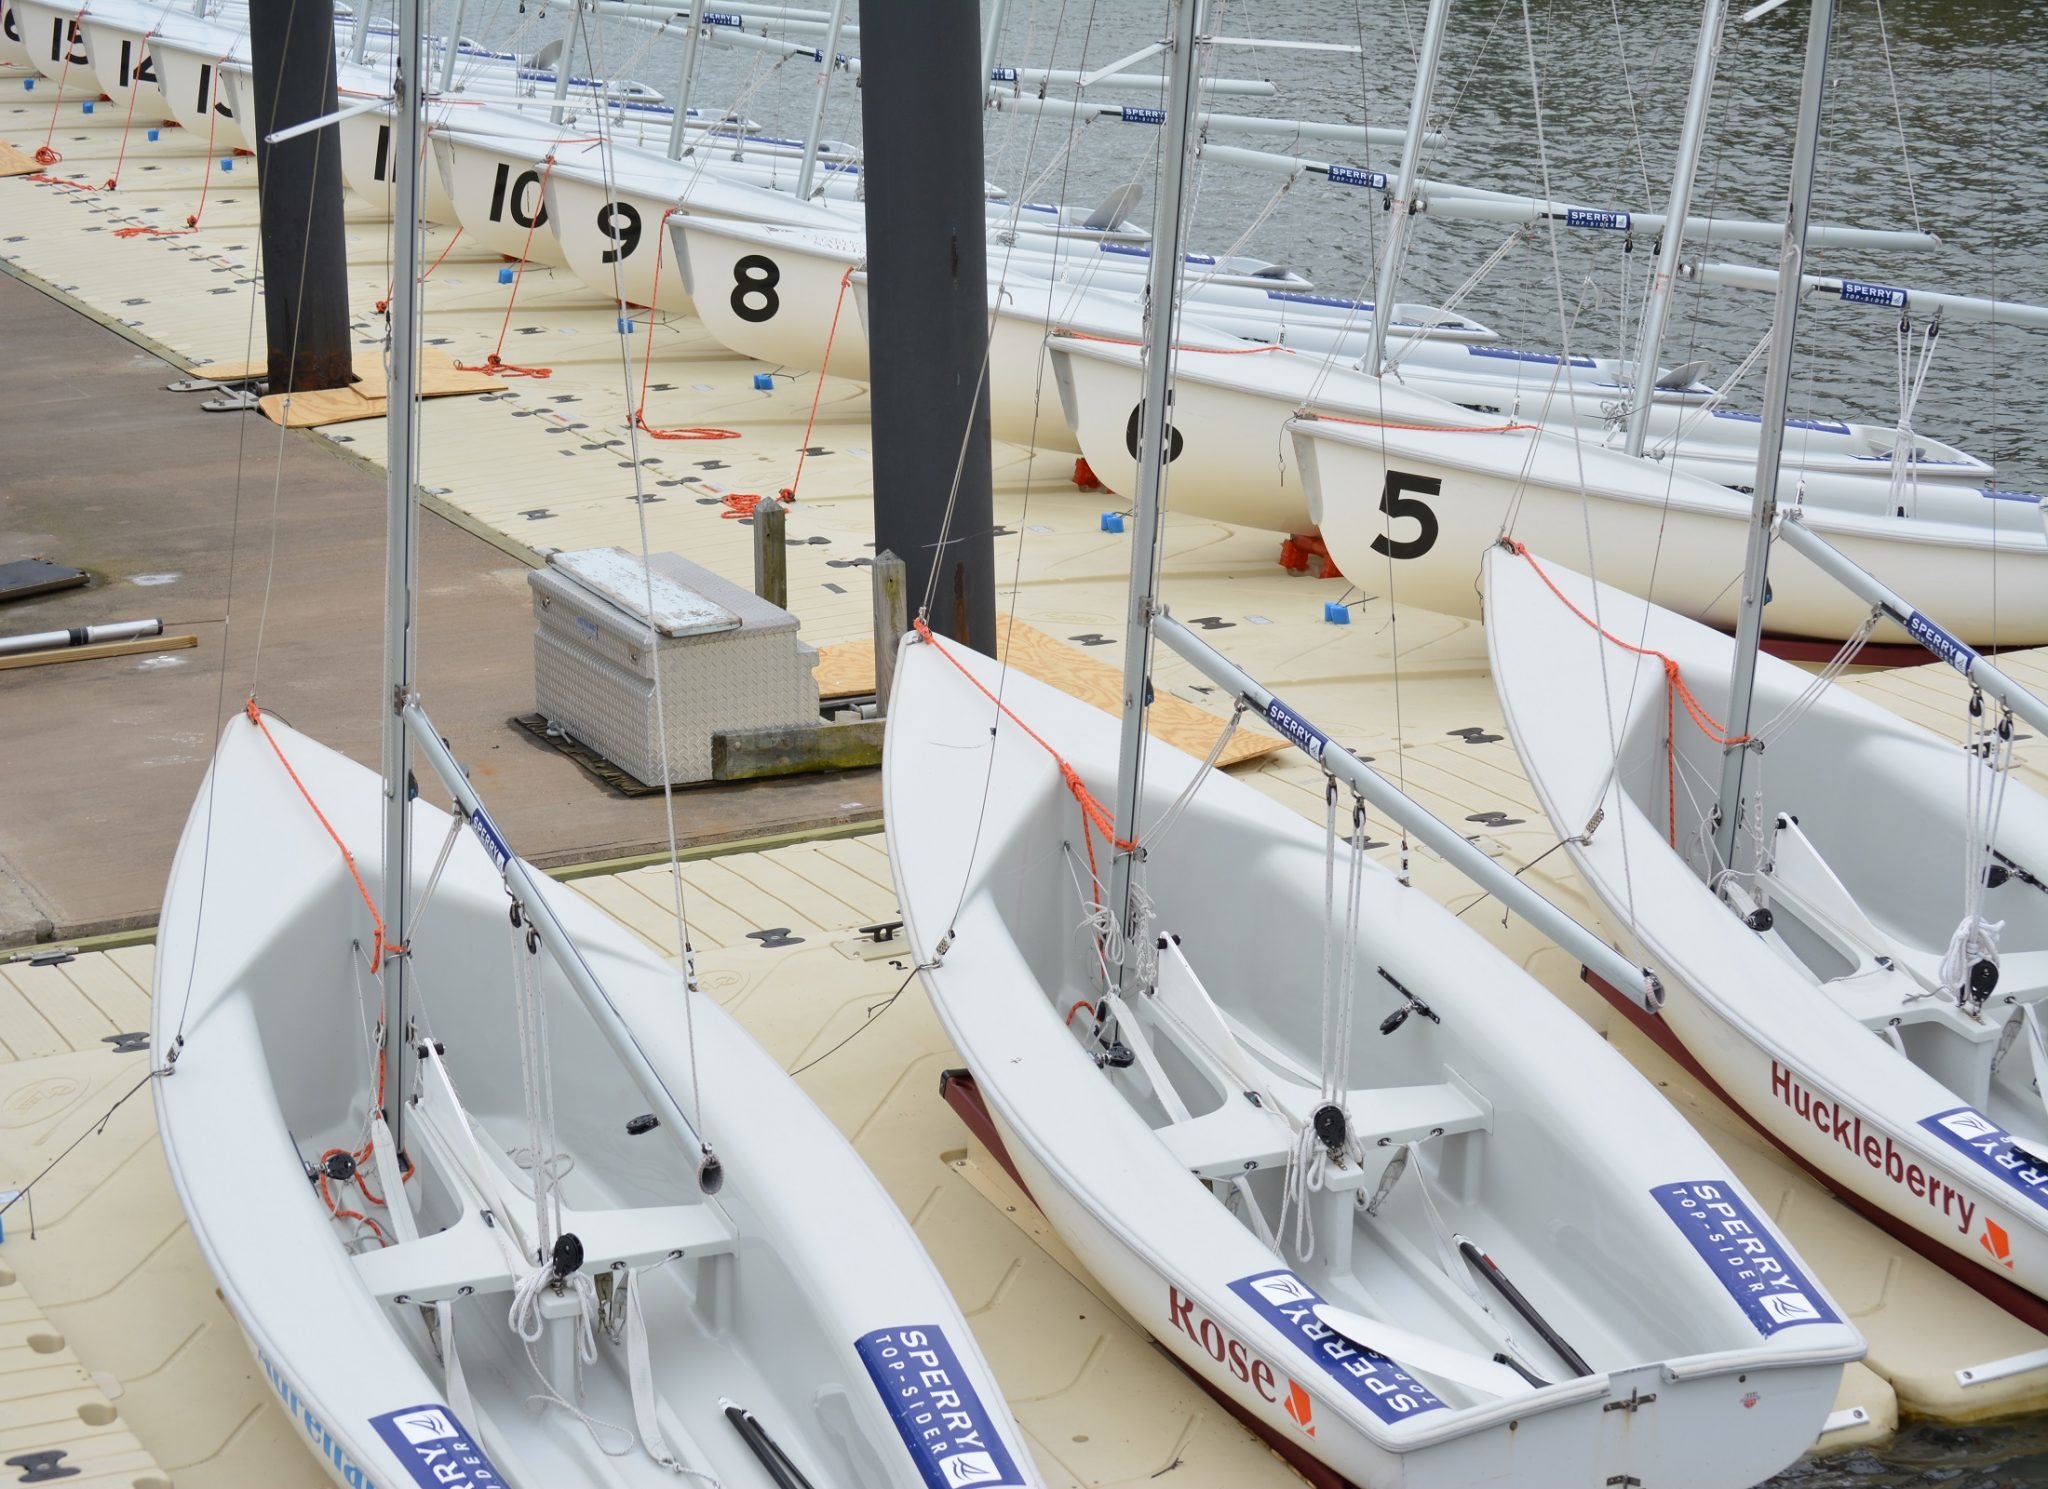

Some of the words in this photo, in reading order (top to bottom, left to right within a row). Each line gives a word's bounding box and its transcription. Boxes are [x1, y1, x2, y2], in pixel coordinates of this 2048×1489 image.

[489, 163, 550, 228] 10
[1332, 167, 1373, 180] SPERRY
[597, 201, 642, 264] 9
[1571, 211, 1616, 222] SPERRY
[730, 254, 780, 323] 8
[1846, 284, 1892, 299] SPERRY
[1126, 389, 1184, 465] 6
[1370, 470, 1442, 560] 5
[1910, 617, 1957, 657] SPERRY
[1269, 705, 1312, 743] SPERRY
[473, 816, 500, 858] SPERRY
[1771, 1060, 1976, 1235] Huckleberry
[1672, 1188, 1765, 1292] TOP-SIDER
[1693, 1185, 1799, 1290] SPERRY
[1168, 1285, 1277, 1404] Rose
[1279, 1308, 1419, 1412] SPERRY
[875, 1334, 949, 1455] TOP-SIDER
[900, 1330, 986, 1449] SPERRY
